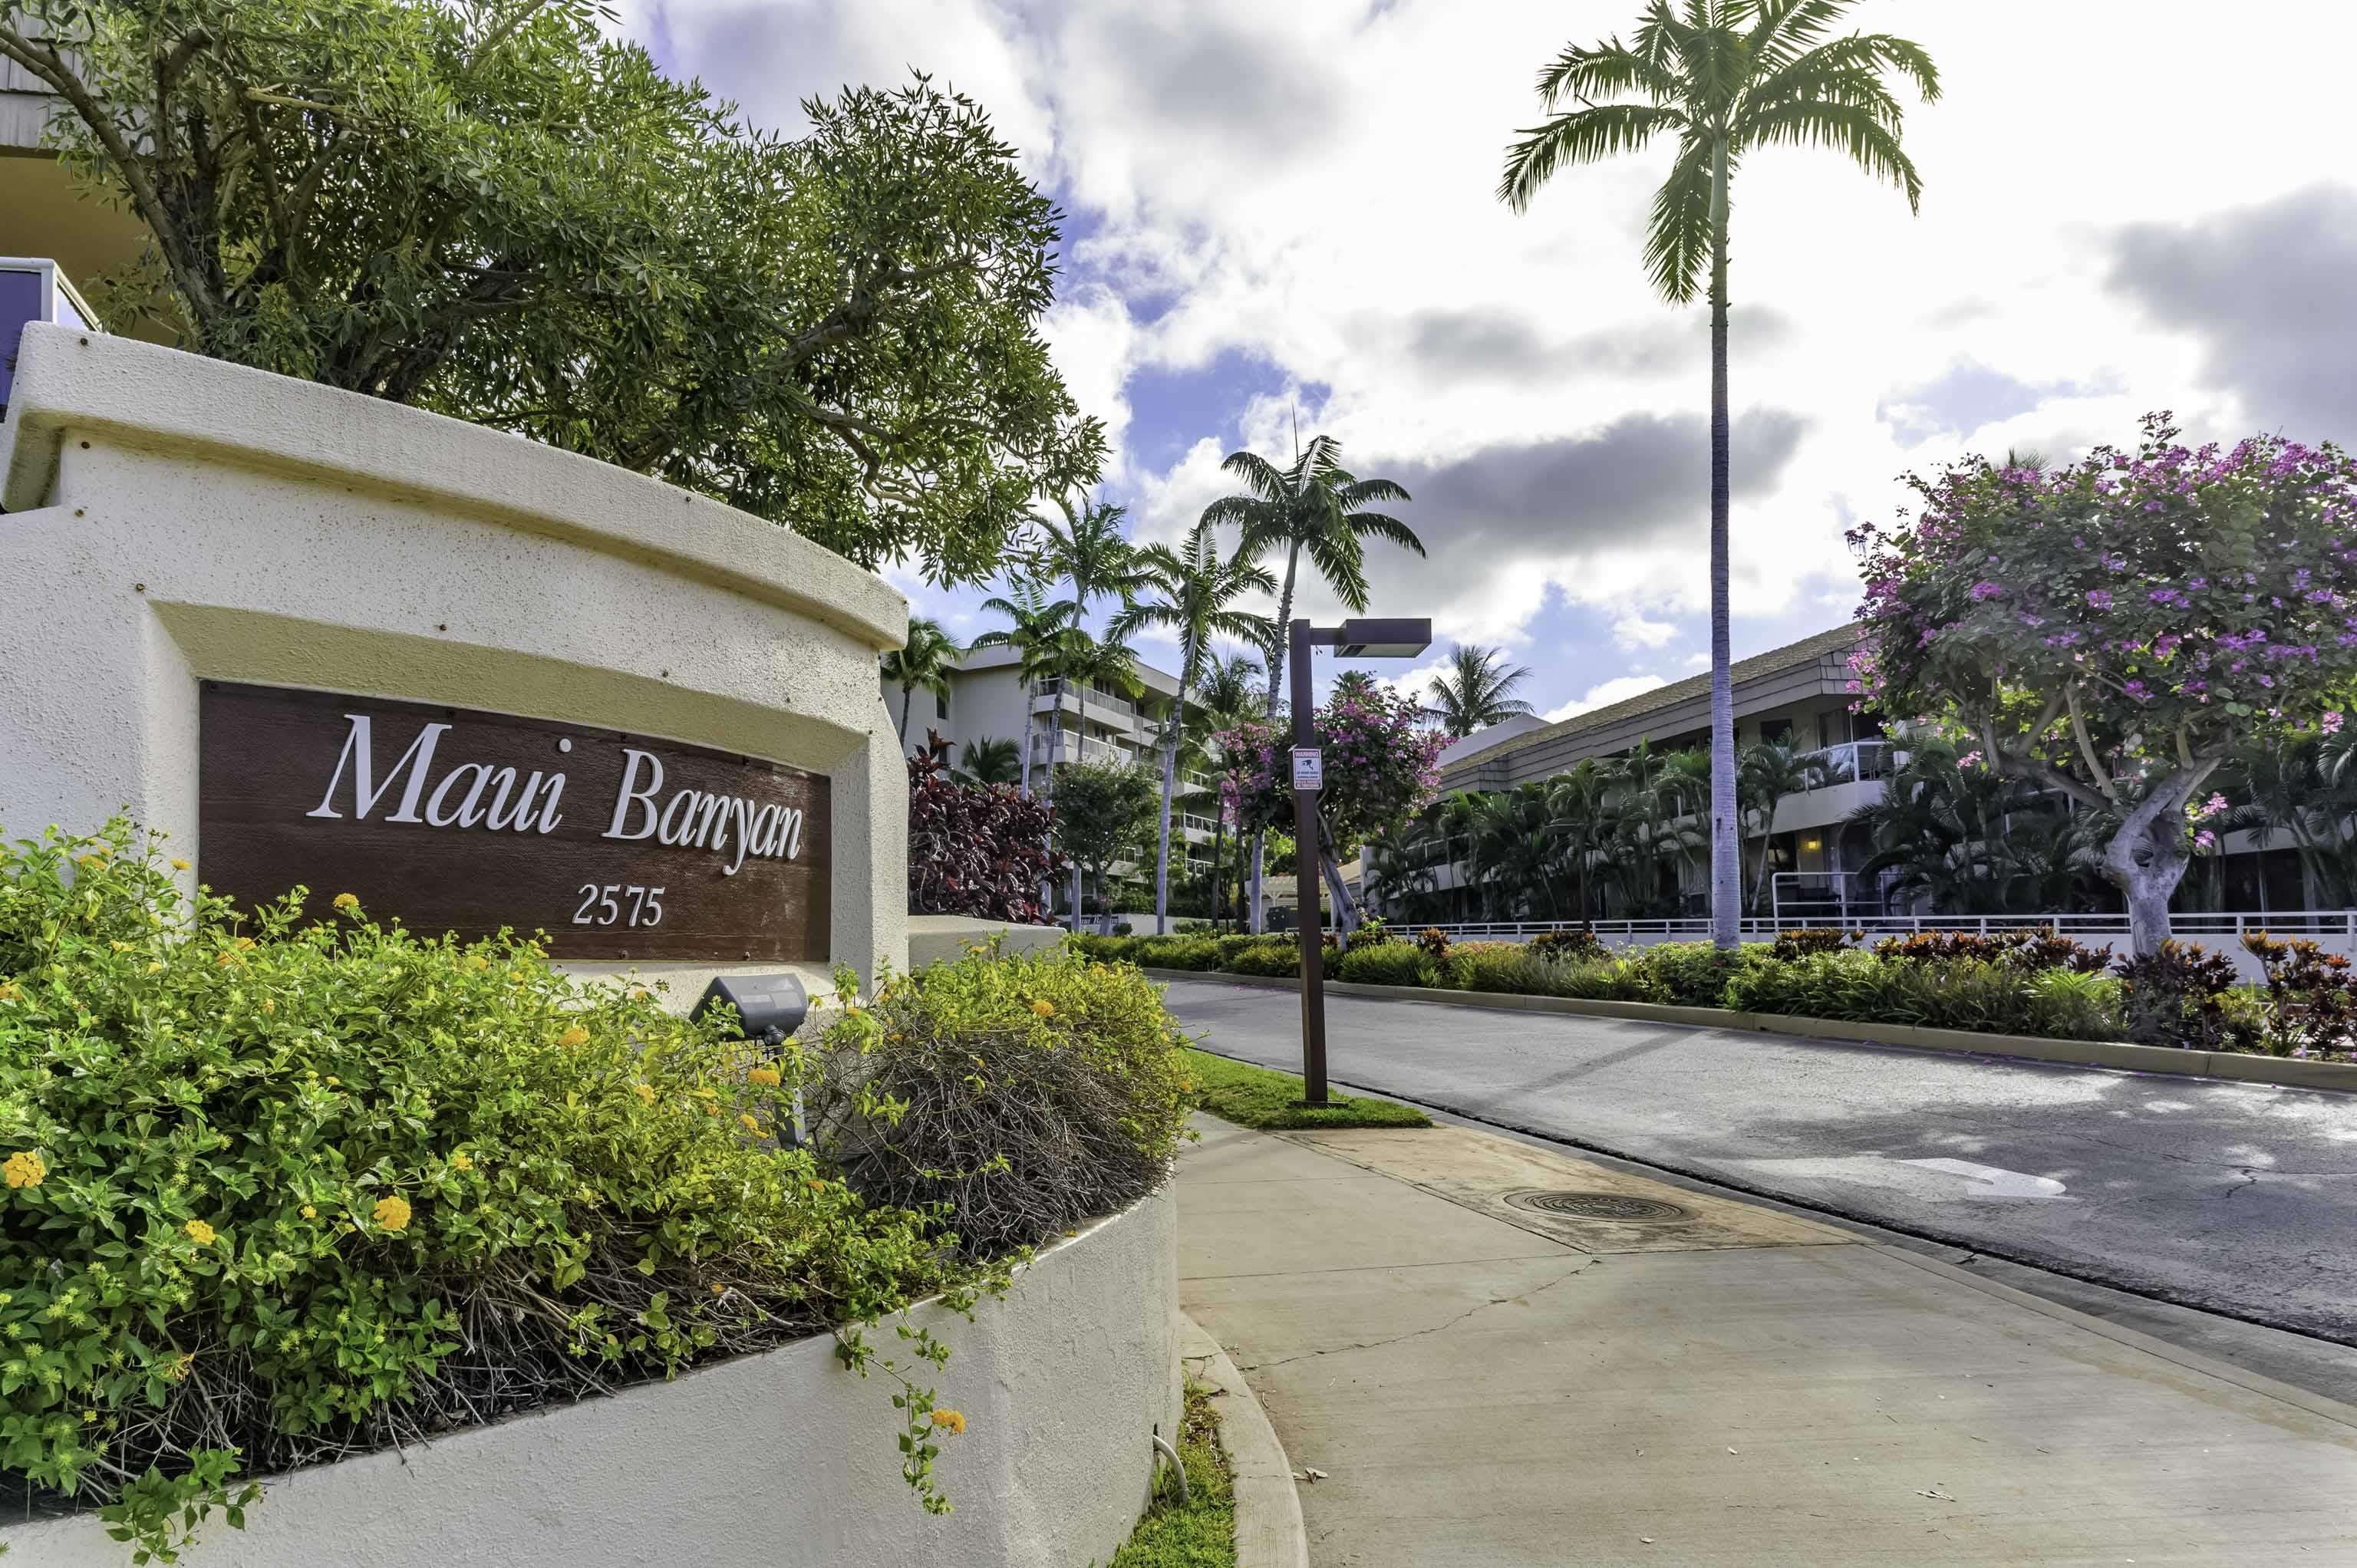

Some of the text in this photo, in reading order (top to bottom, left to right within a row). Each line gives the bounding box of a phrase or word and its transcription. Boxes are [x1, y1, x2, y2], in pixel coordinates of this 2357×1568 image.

[305, 714, 803, 875] Maui Banyan
[572, 884, 666, 927] 2575
